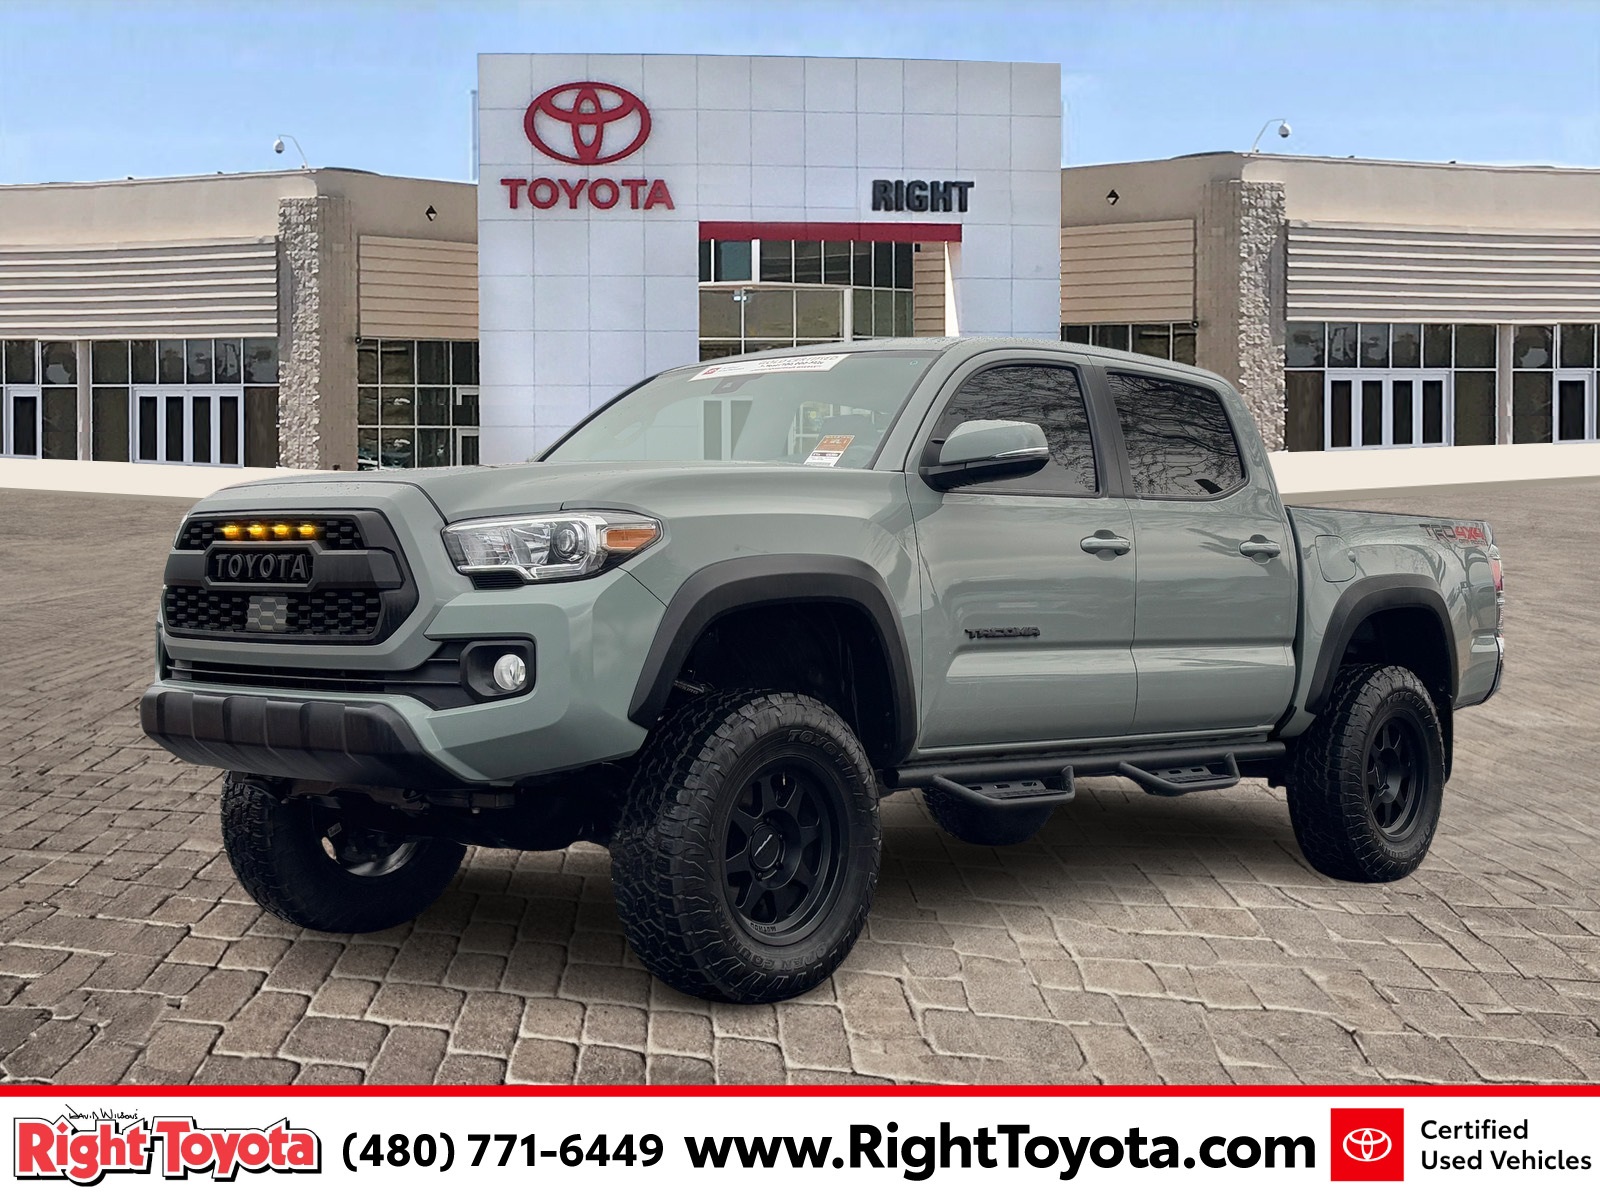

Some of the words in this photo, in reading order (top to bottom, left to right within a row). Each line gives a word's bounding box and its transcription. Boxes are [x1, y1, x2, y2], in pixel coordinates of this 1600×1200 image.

[500, 179, 675, 210] TOYOTA
[872, 180, 974, 213] RIGHT
[1419, 523, 1456, 541] TRD
[215, 553, 307, 580] TOYOTA
